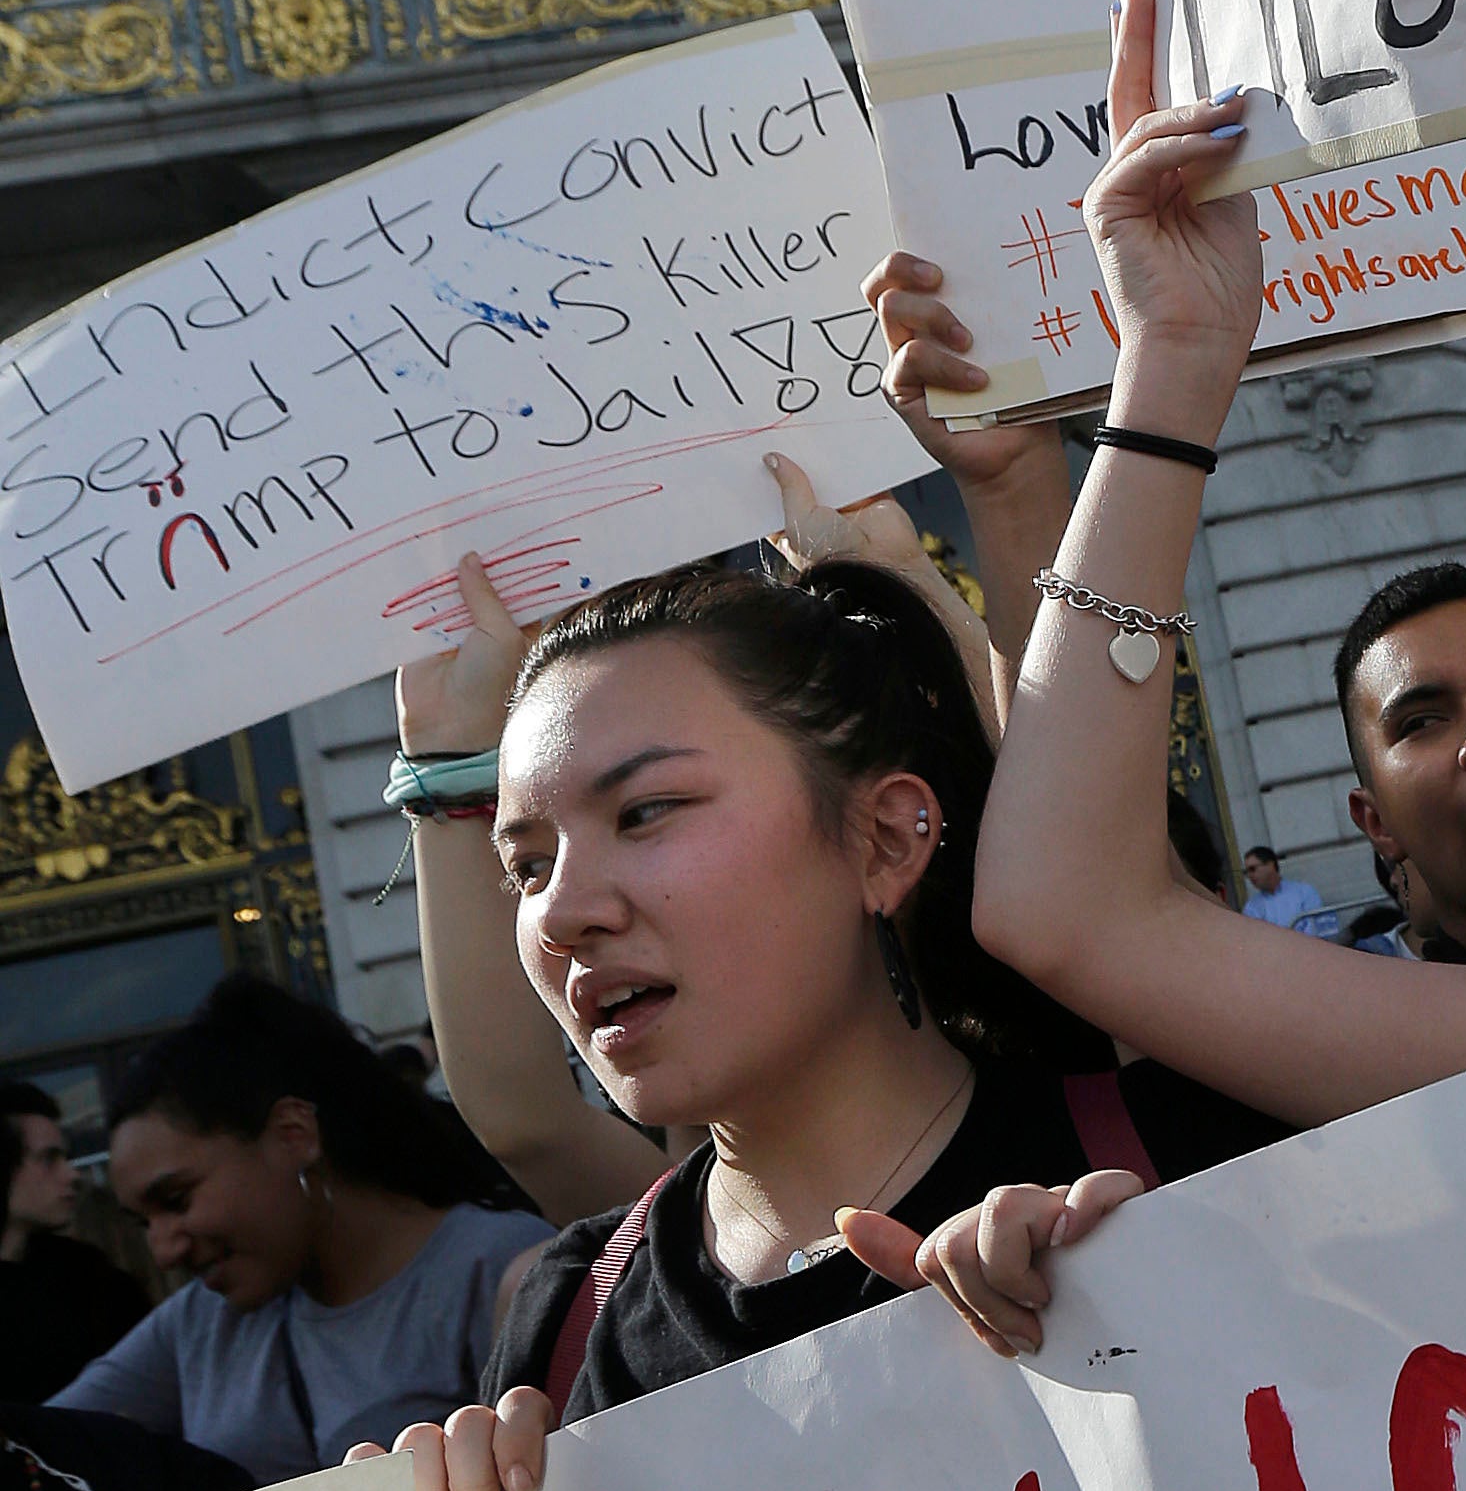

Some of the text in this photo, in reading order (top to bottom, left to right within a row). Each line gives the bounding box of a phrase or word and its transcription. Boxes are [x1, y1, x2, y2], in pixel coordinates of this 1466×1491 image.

[946, 92, 1110, 172] Lov
[0, 76, 846, 441] Indict, Convict
[1, 211, 851, 539] Send this Killer
[373, 407, 500, 478] to
